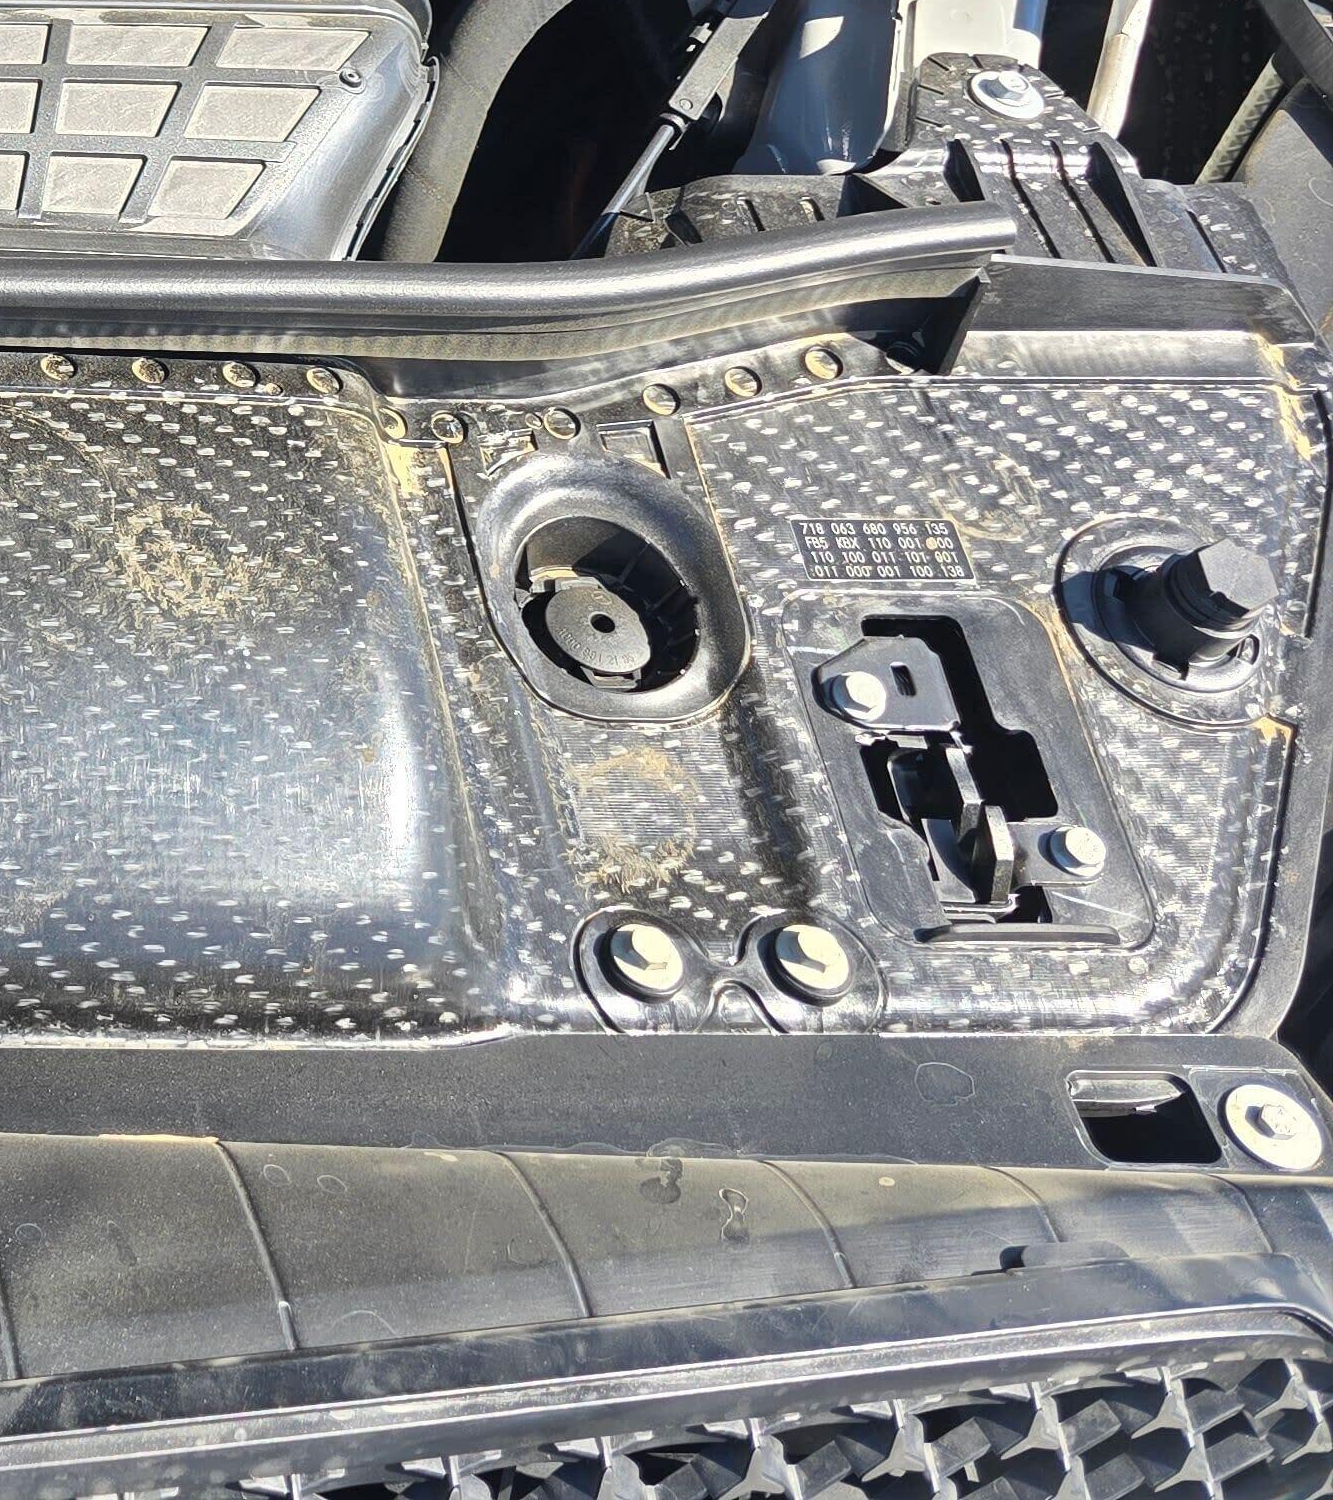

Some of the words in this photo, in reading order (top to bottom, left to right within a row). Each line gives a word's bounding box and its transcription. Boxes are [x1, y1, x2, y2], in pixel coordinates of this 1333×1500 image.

[799, 522, 825, 535] 718
[831, 522, 855, 535] 063
[863, 522, 886, 535] 680
[893, 522, 917, 535] 956
[925, 522, 949, 535] 135
[805, 537, 829, 550] FB5
[836, 537, 860, 550] KBX
[868, 537, 891, 550] 110
[898, 537, 921, 550] 001
[926, 537, 953, 550] 00
[811, 551, 834, 564] 110
[842, 551, 865, 564] 100
[872, 551, 896, 564] 011
[905, 551, 926, 564] 101
[935, 551, 959, 564] 001
[816, 566, 839, 578] 011
[846, 566, 870, 578] 000
[878, 566, 901, 578] 001
[910, 566, 933, 578] 100
[941, 566, 965, 578] 138
